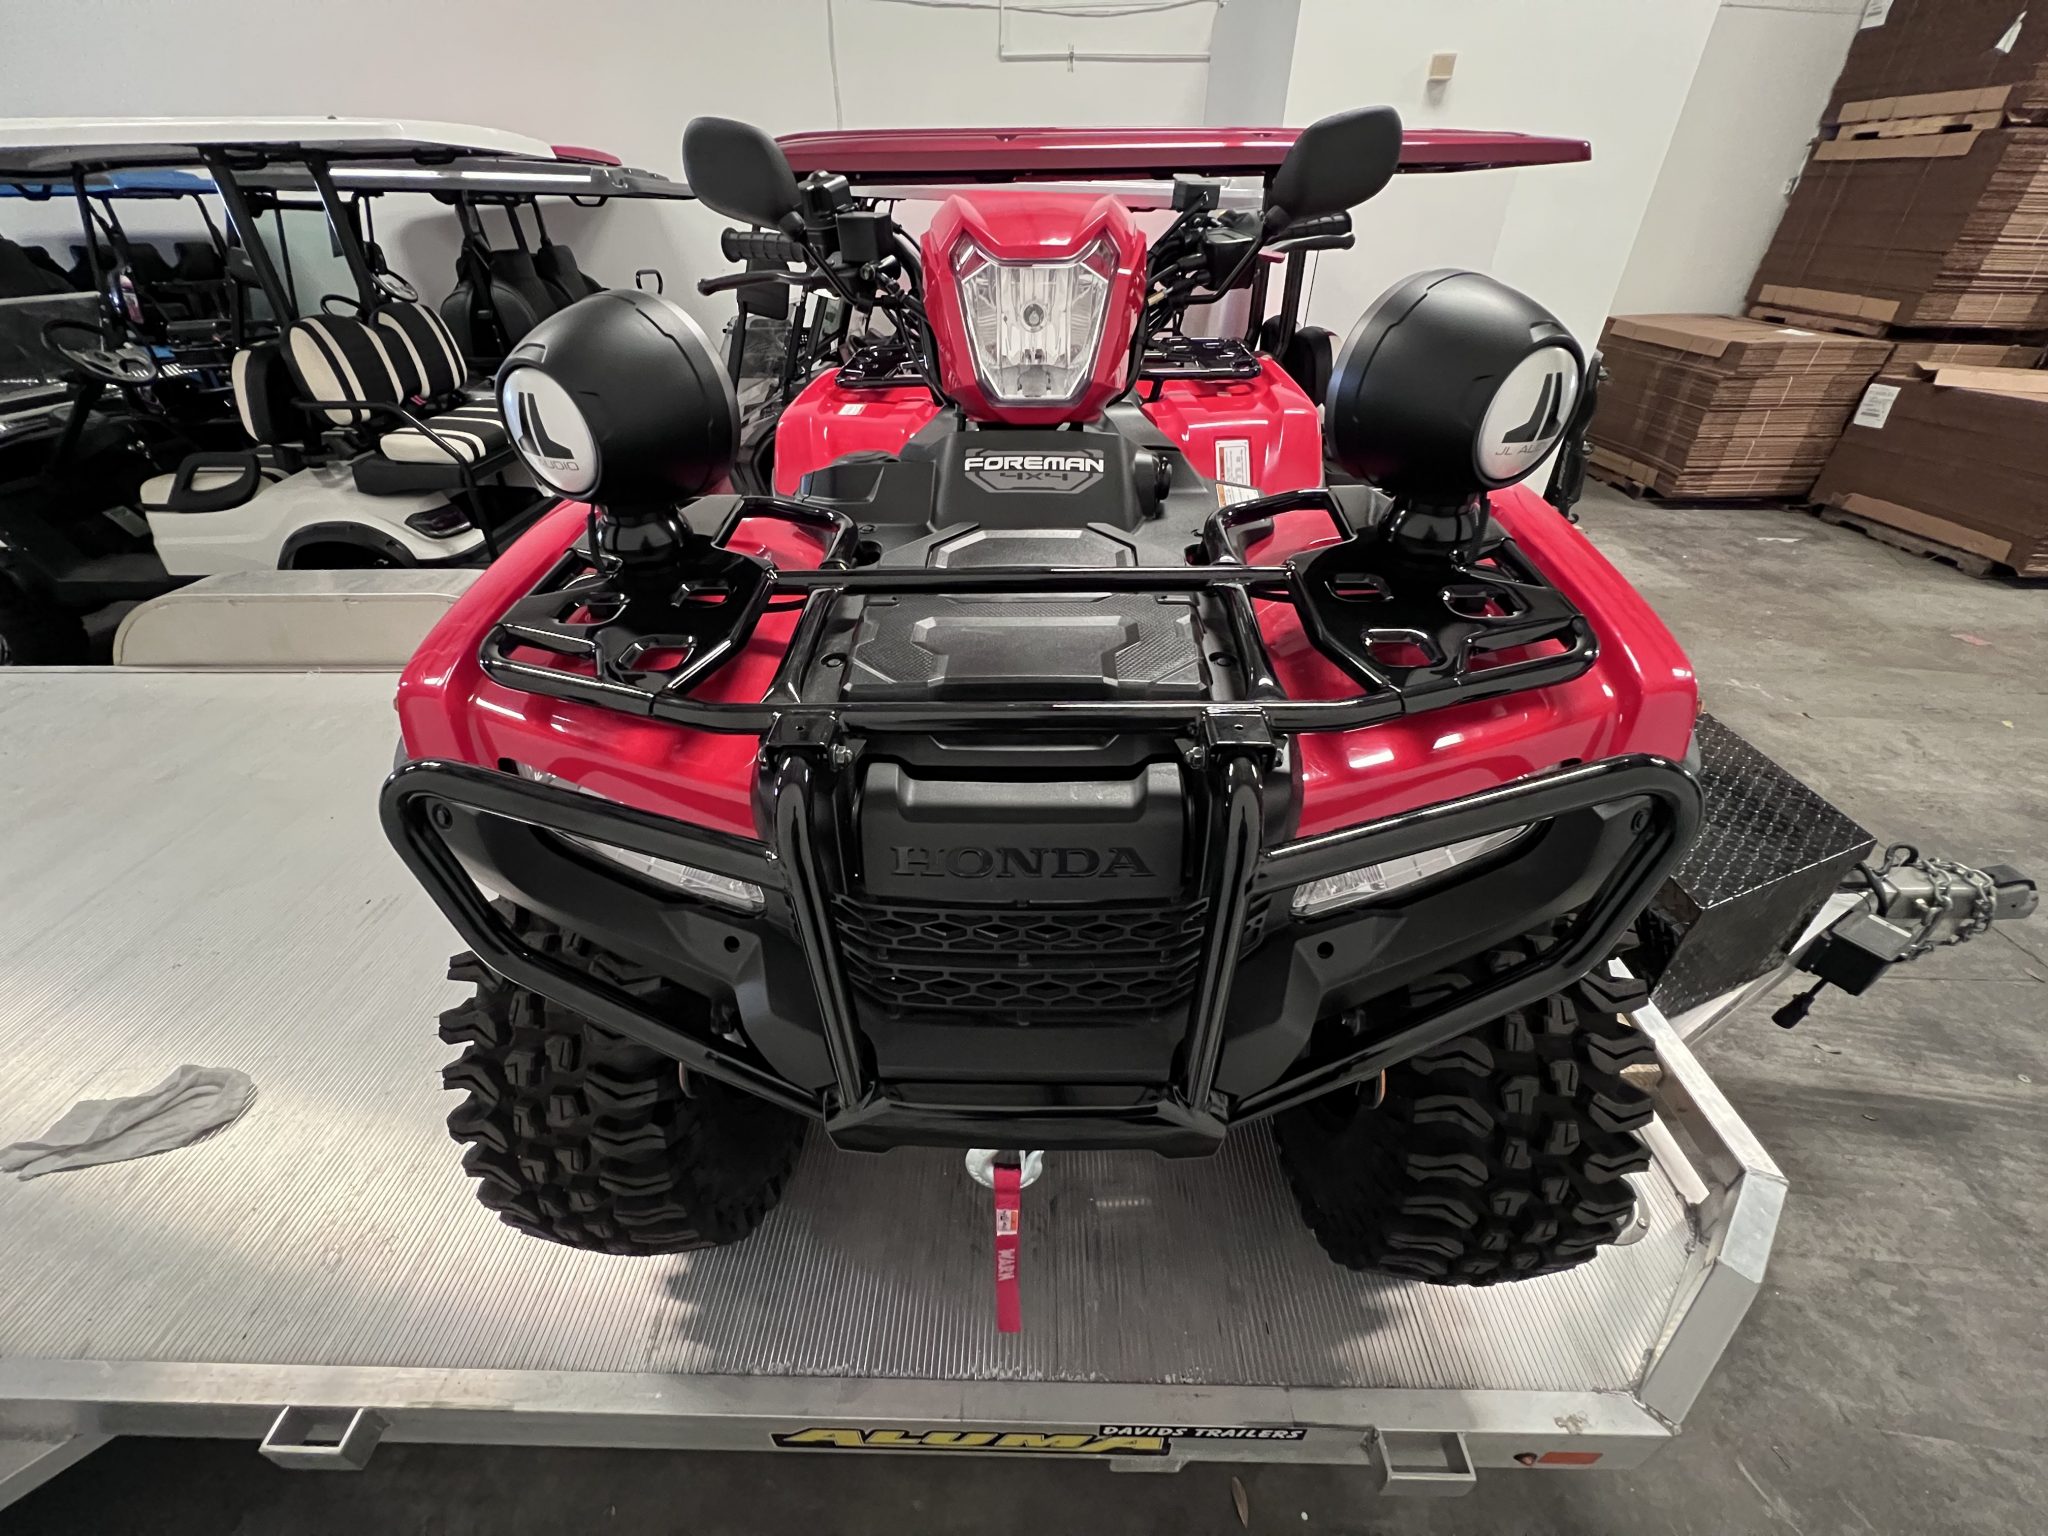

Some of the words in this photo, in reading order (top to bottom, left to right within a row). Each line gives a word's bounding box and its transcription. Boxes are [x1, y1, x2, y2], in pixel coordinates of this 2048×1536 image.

[964, 456, 1104, 473] FOREMAN
[890, 846, 1156, 878] HONDA
[781, 1428, 1165, 1453] ALUMA
[1102, 1425, 1188, 1437] DAVIDS
[1194, 1427, 1304, 1440] TRAILERS
